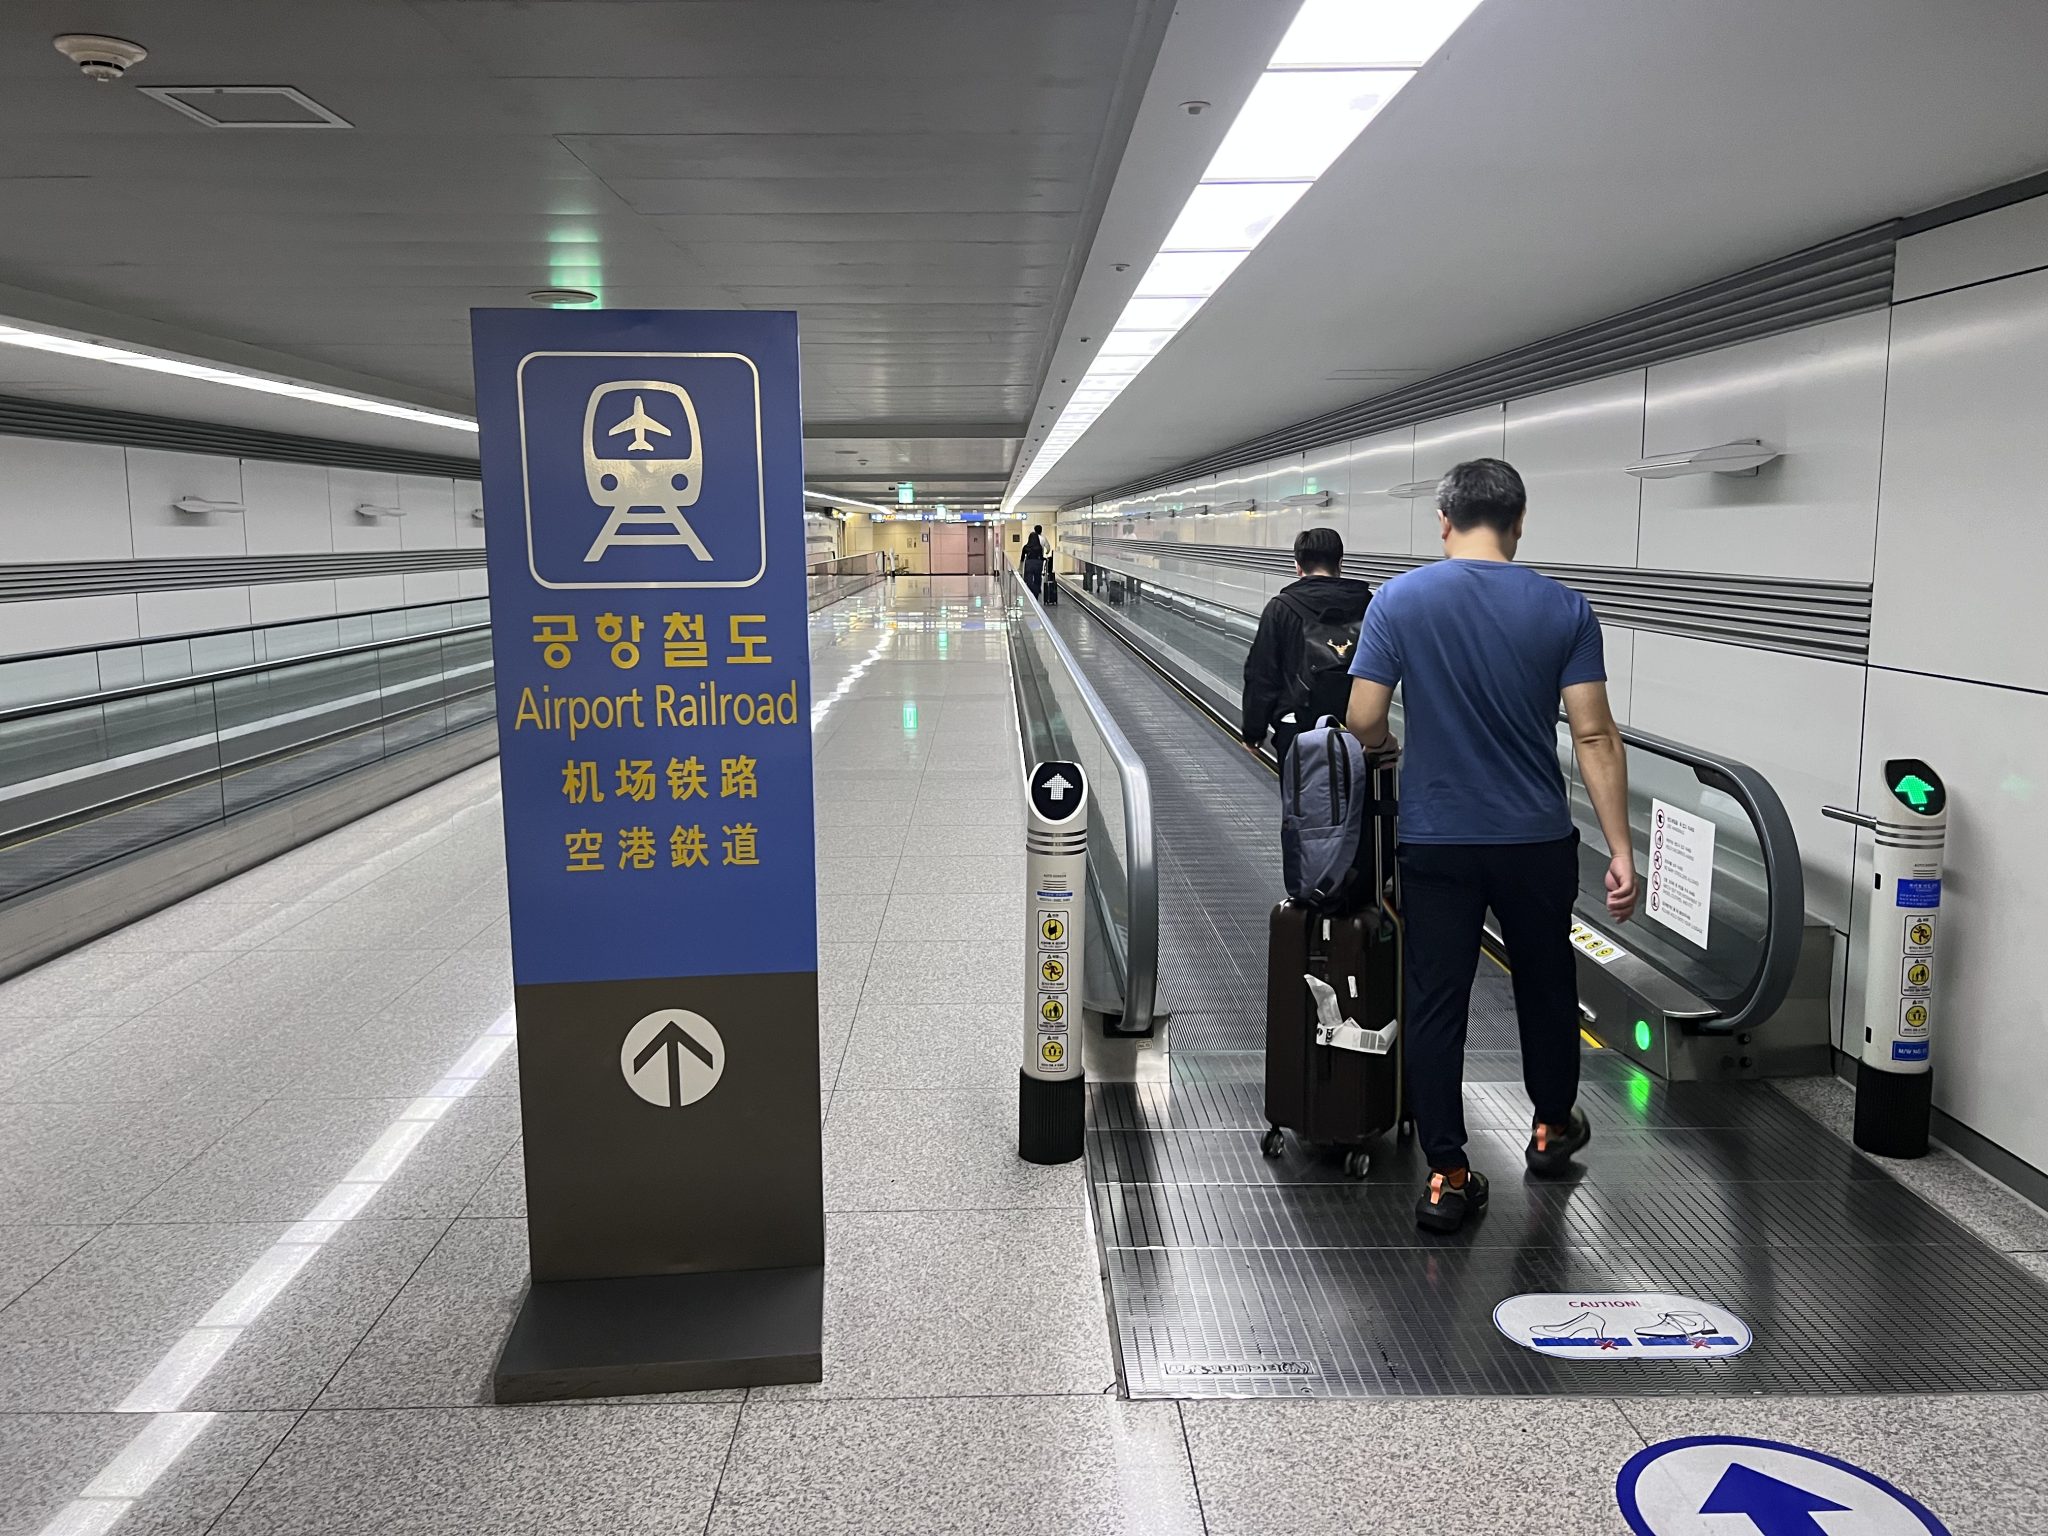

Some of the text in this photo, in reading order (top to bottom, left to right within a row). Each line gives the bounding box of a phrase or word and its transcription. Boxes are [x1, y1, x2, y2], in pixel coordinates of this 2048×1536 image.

[532, 612, 772, 669] 공항철도
[515, 681, 797, 740] Airport Railroad
[563, 755, 757, 803] 机场铁路
[565, 824, 758, 871] 空港鉄道
